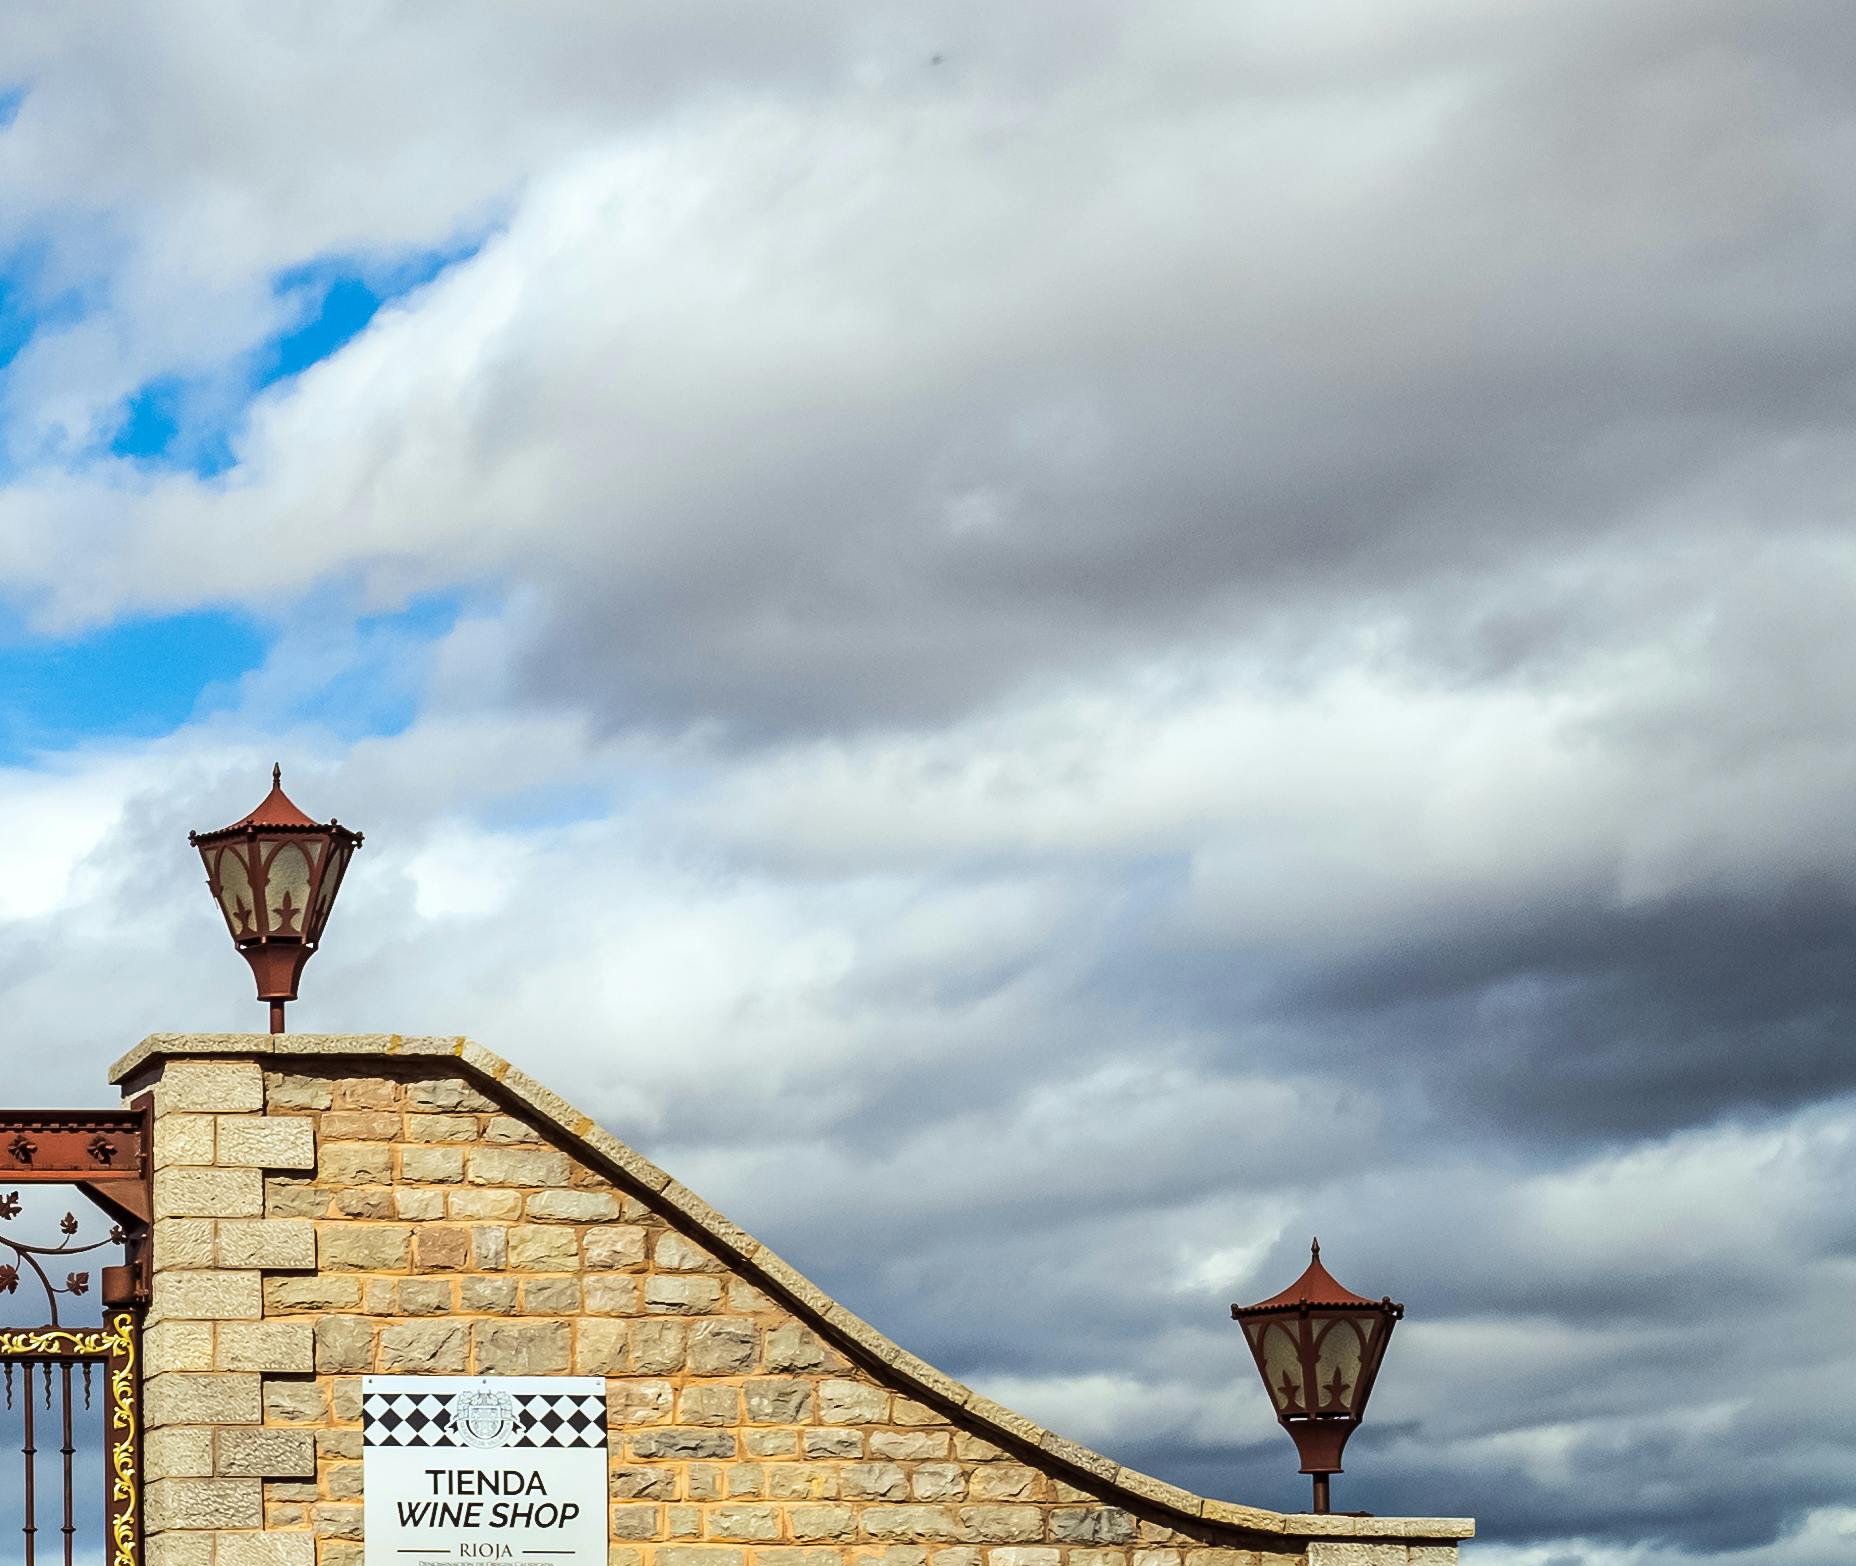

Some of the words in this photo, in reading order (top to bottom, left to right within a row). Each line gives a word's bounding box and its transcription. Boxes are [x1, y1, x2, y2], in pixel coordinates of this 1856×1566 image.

[424, 1469, 548, 1496] TIENDA
[396, 1501, 484, 1528] WINE
[488, 1502, 580, 1529] SHOP
[459, 1542, 513, 1560] RIOJA
